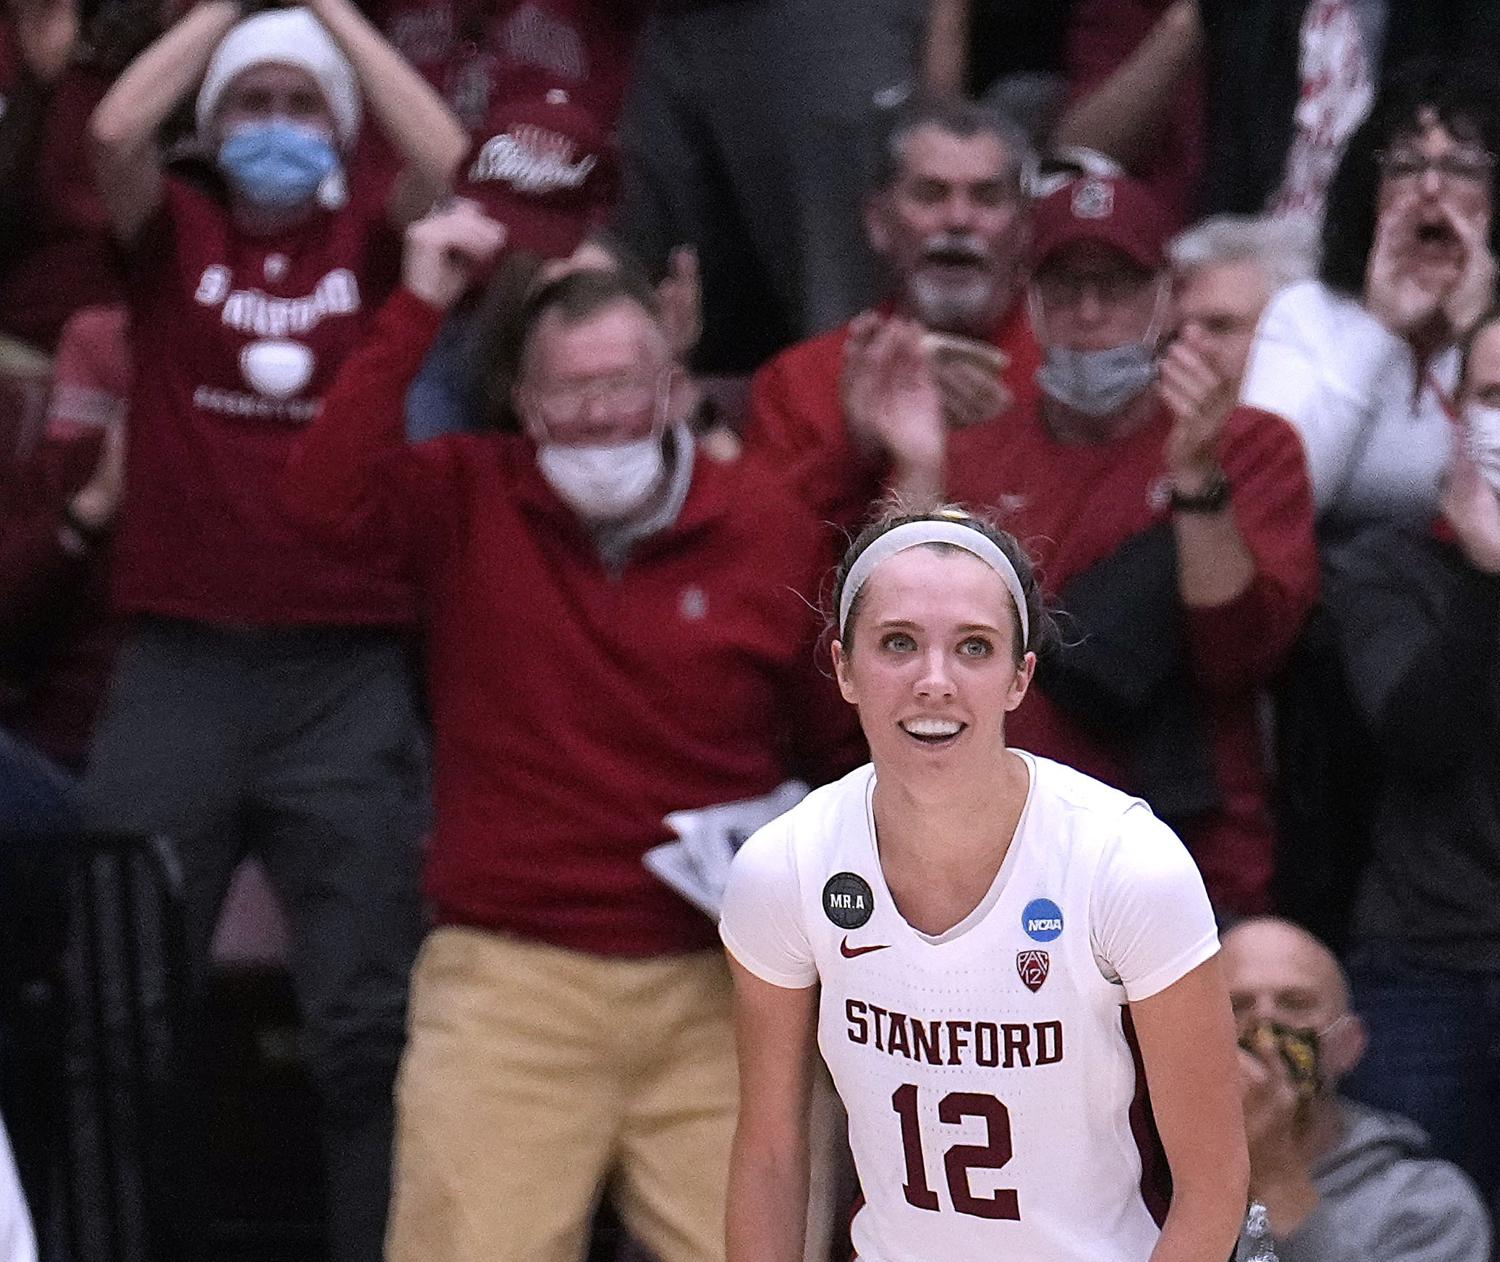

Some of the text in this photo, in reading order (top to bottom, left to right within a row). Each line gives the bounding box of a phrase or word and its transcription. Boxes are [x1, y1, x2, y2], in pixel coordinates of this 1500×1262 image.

[830, 893, 865, 910] MR.A
[1028, 919, 1063, 932] NCAA
[1018, 951, 1048, 976] PAC
[1025, 968, 1042, 985] 12
[845, 998, 1064, 1068] STANFORD
[891, 1083, 1021, 1221] 12
